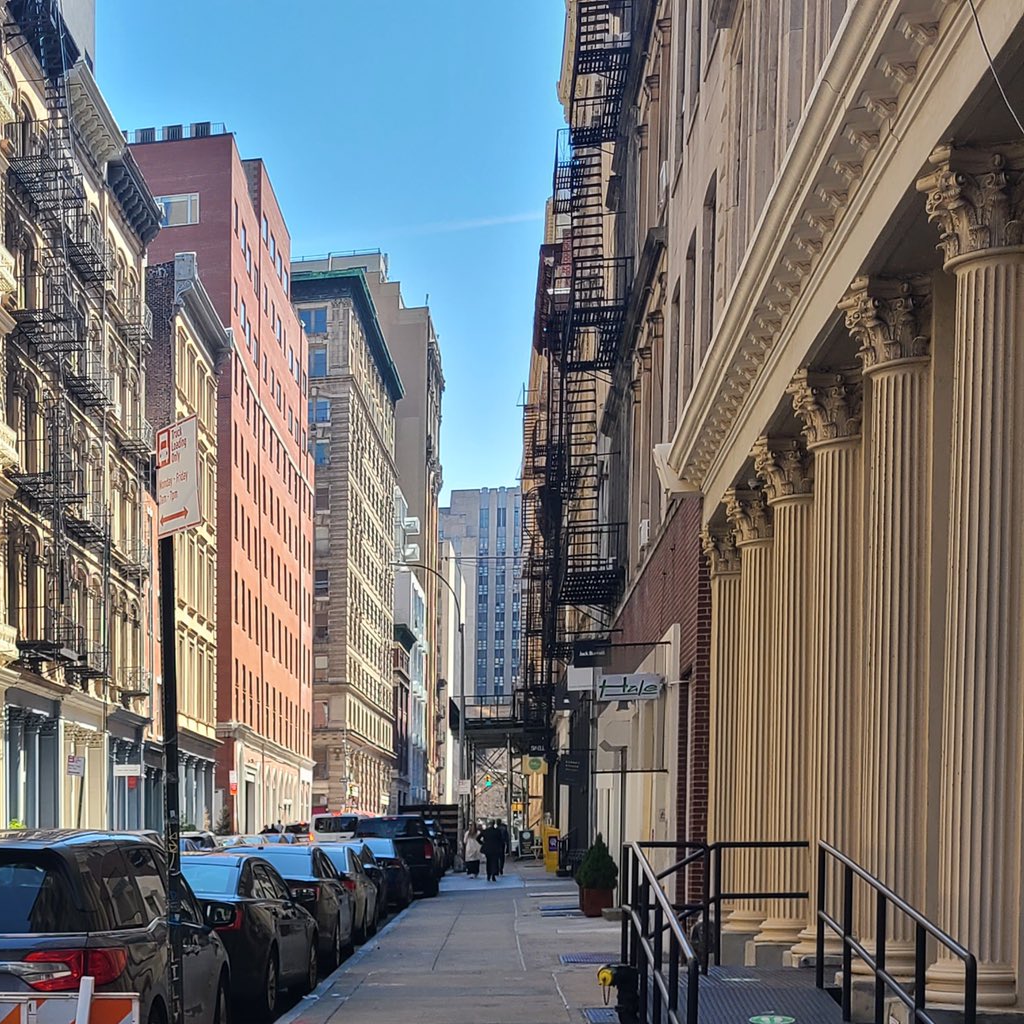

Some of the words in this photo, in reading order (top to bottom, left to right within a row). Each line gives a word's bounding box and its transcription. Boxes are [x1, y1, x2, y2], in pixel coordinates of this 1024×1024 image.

[172, 428, 182, 439] Truck
[172, 438, 187, 452] Loading
[171, 452, 180, 463] Only
[599, 677, 657, 698] Hale
